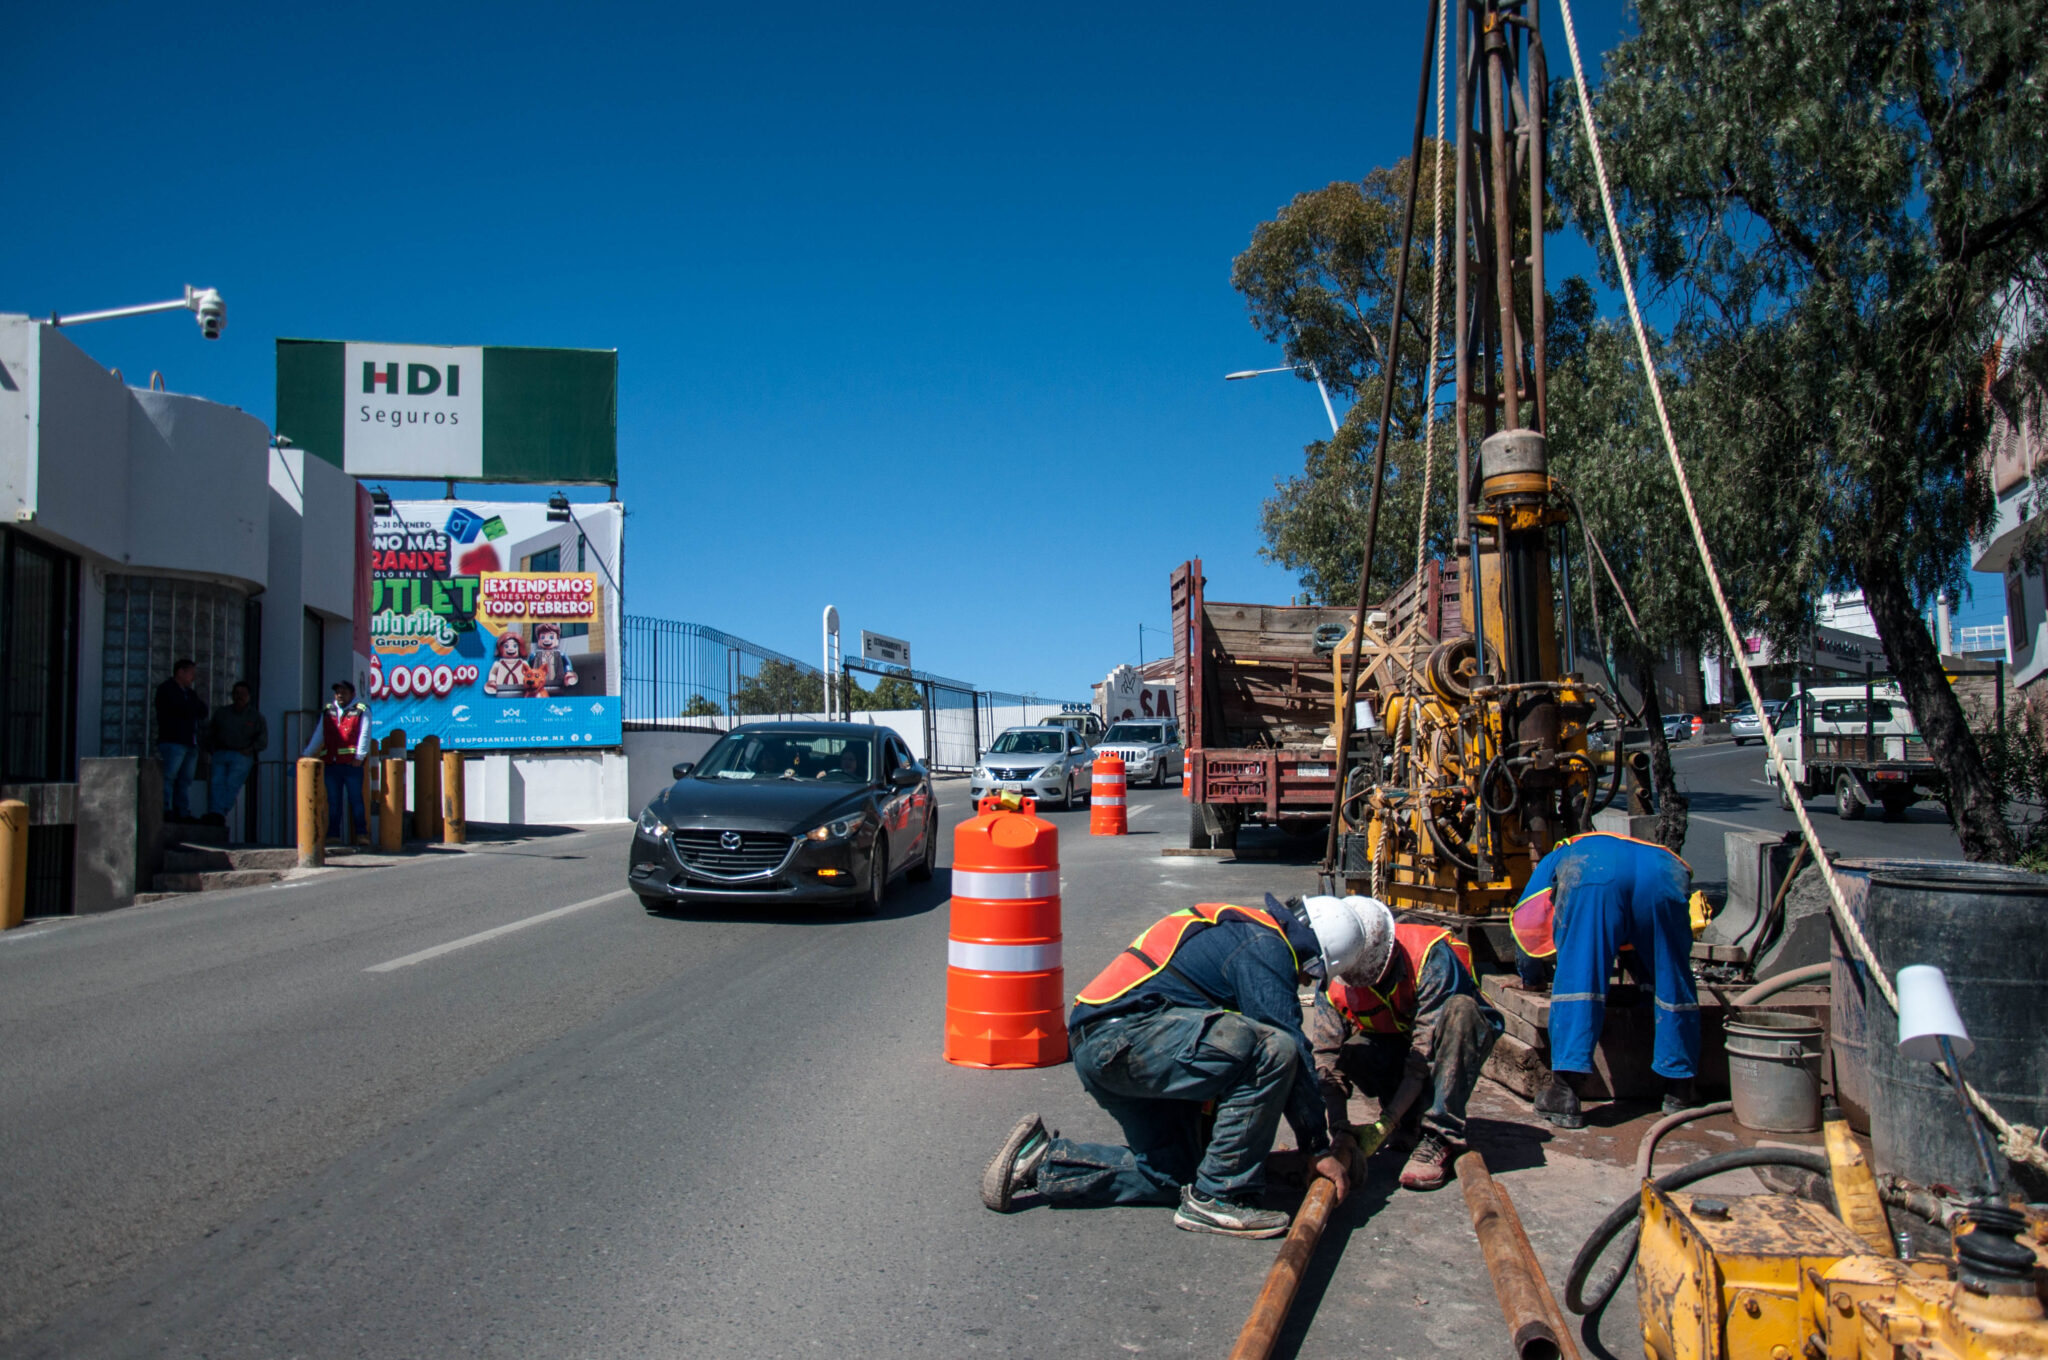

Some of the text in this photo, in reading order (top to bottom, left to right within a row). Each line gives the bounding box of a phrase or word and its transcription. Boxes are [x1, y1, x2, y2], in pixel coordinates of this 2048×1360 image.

[363, 361, 460, 397] HDI
[360, 405, 460, 428] Seguros
[404, 521, 432, 529] ENERO
[373, 532, 447, 551] NO MÁS
[399, 570, 412, 578] EN
[416, 570, 429, 578] EL
[484, 579, 594, 593] ¡EXTENDEMOS
[484, 601, 594, 615] TODO FEBRERO!
[375, 638, 419, 648] Grupo
[866, 638, 872, 651] E
[903, 648, 909, 660] E
[1140, 689, 1177, 718] SA
